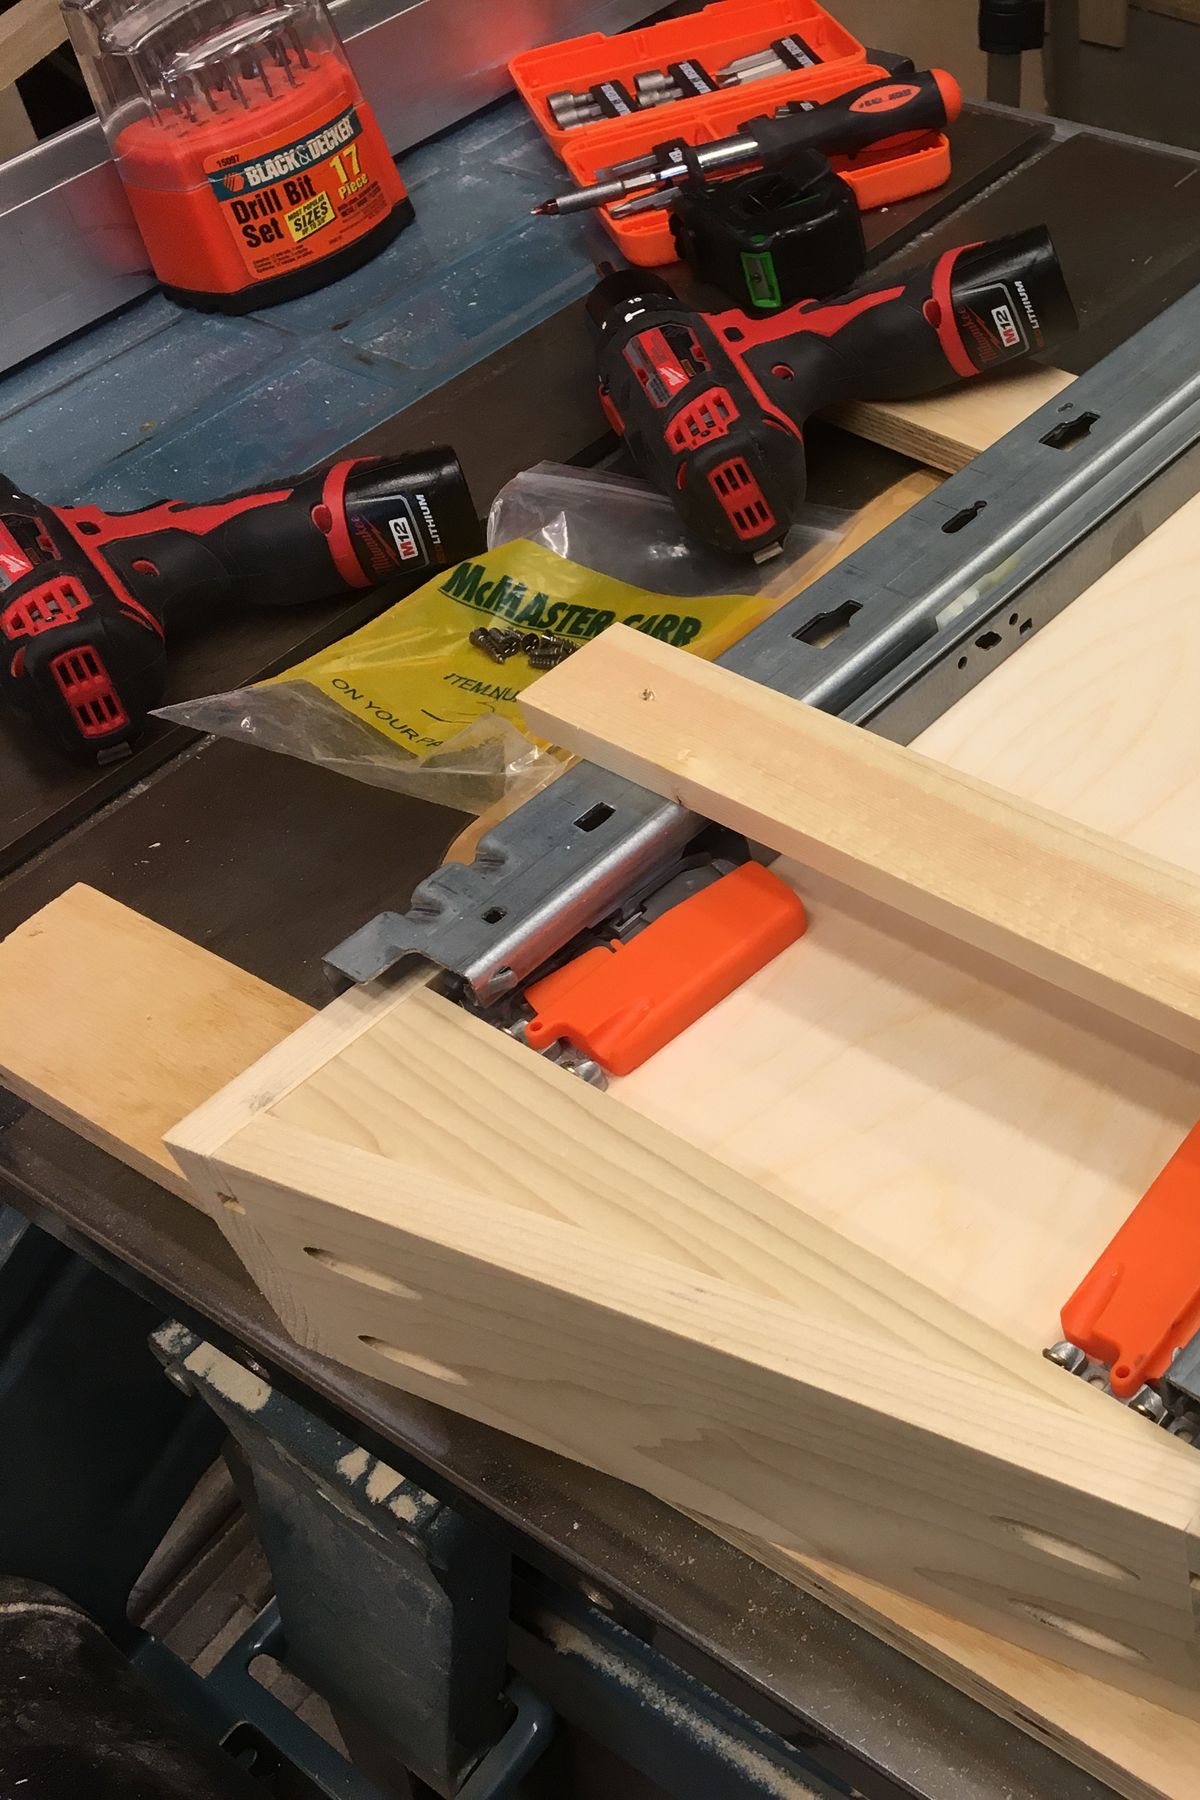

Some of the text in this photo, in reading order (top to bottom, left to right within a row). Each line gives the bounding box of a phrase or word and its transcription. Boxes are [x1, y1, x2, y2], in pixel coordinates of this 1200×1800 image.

[216, 154, 240, 168] 15097
[329, 143, 362, 184] 17
[230, 188, 283, 225] Drill
[283, 174, 317, 206] Bit
[293, 200, 329, 233] SIZES
[241, 217, 285, 248] Set
[1014, 280, 1040, 329] LITHIUM
[995, 309, 1018, 345] M12
[415, 494, 441, 545] LITHIUM
[393, 521, 416, 558] M12
[443, 672, 491, 697] ITEM
[331, 678, 365, 700] ON
[364, 700, 420, 741] YOUR
